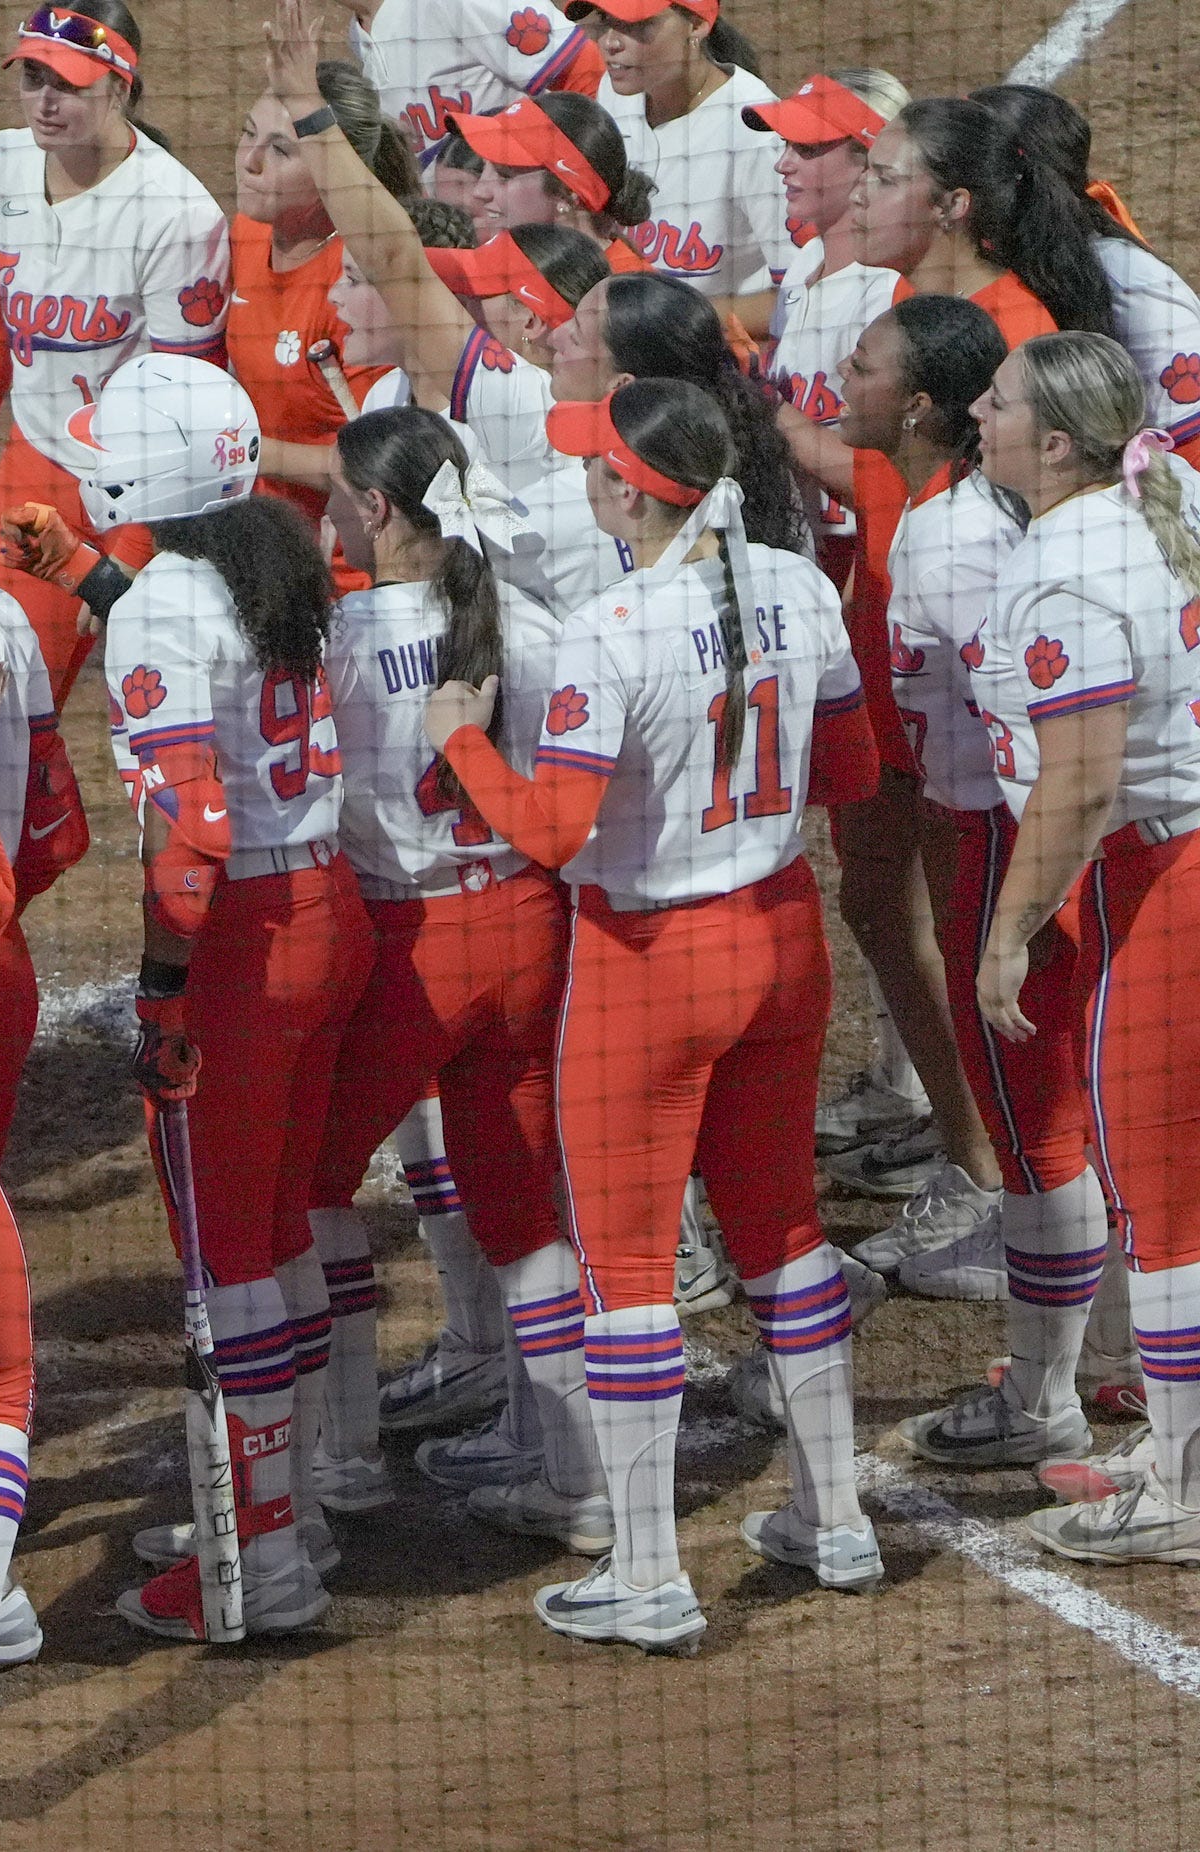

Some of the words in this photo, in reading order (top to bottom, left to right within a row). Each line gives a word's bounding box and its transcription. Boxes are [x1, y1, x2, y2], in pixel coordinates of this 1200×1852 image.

[228, 446, 246, 467] 99
[377, 634, 450, 695] DUN
[691, 604, 788, 675] PASE
[701, 674, 792, 834] 11
[184, 869, 199, 889] C
